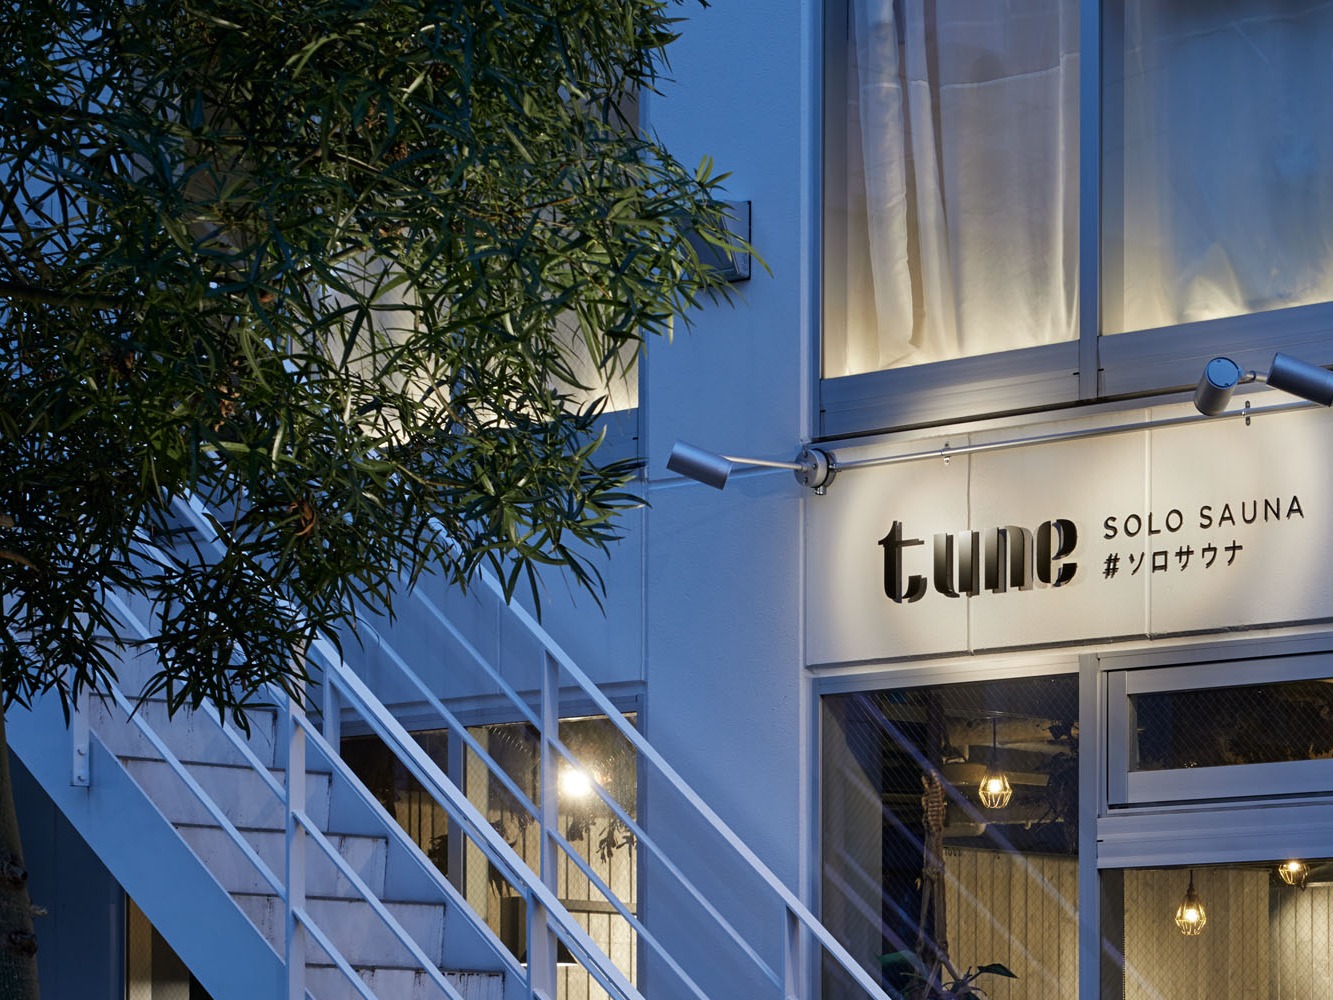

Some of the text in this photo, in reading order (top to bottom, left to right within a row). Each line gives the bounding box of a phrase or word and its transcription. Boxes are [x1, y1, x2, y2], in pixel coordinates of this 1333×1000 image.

[1103, 495, 1305, 540] SOLO SAUNA
[877, 519, 1078, 604] tune
[1103, 540, 1244, 579] #ソロサウナ
